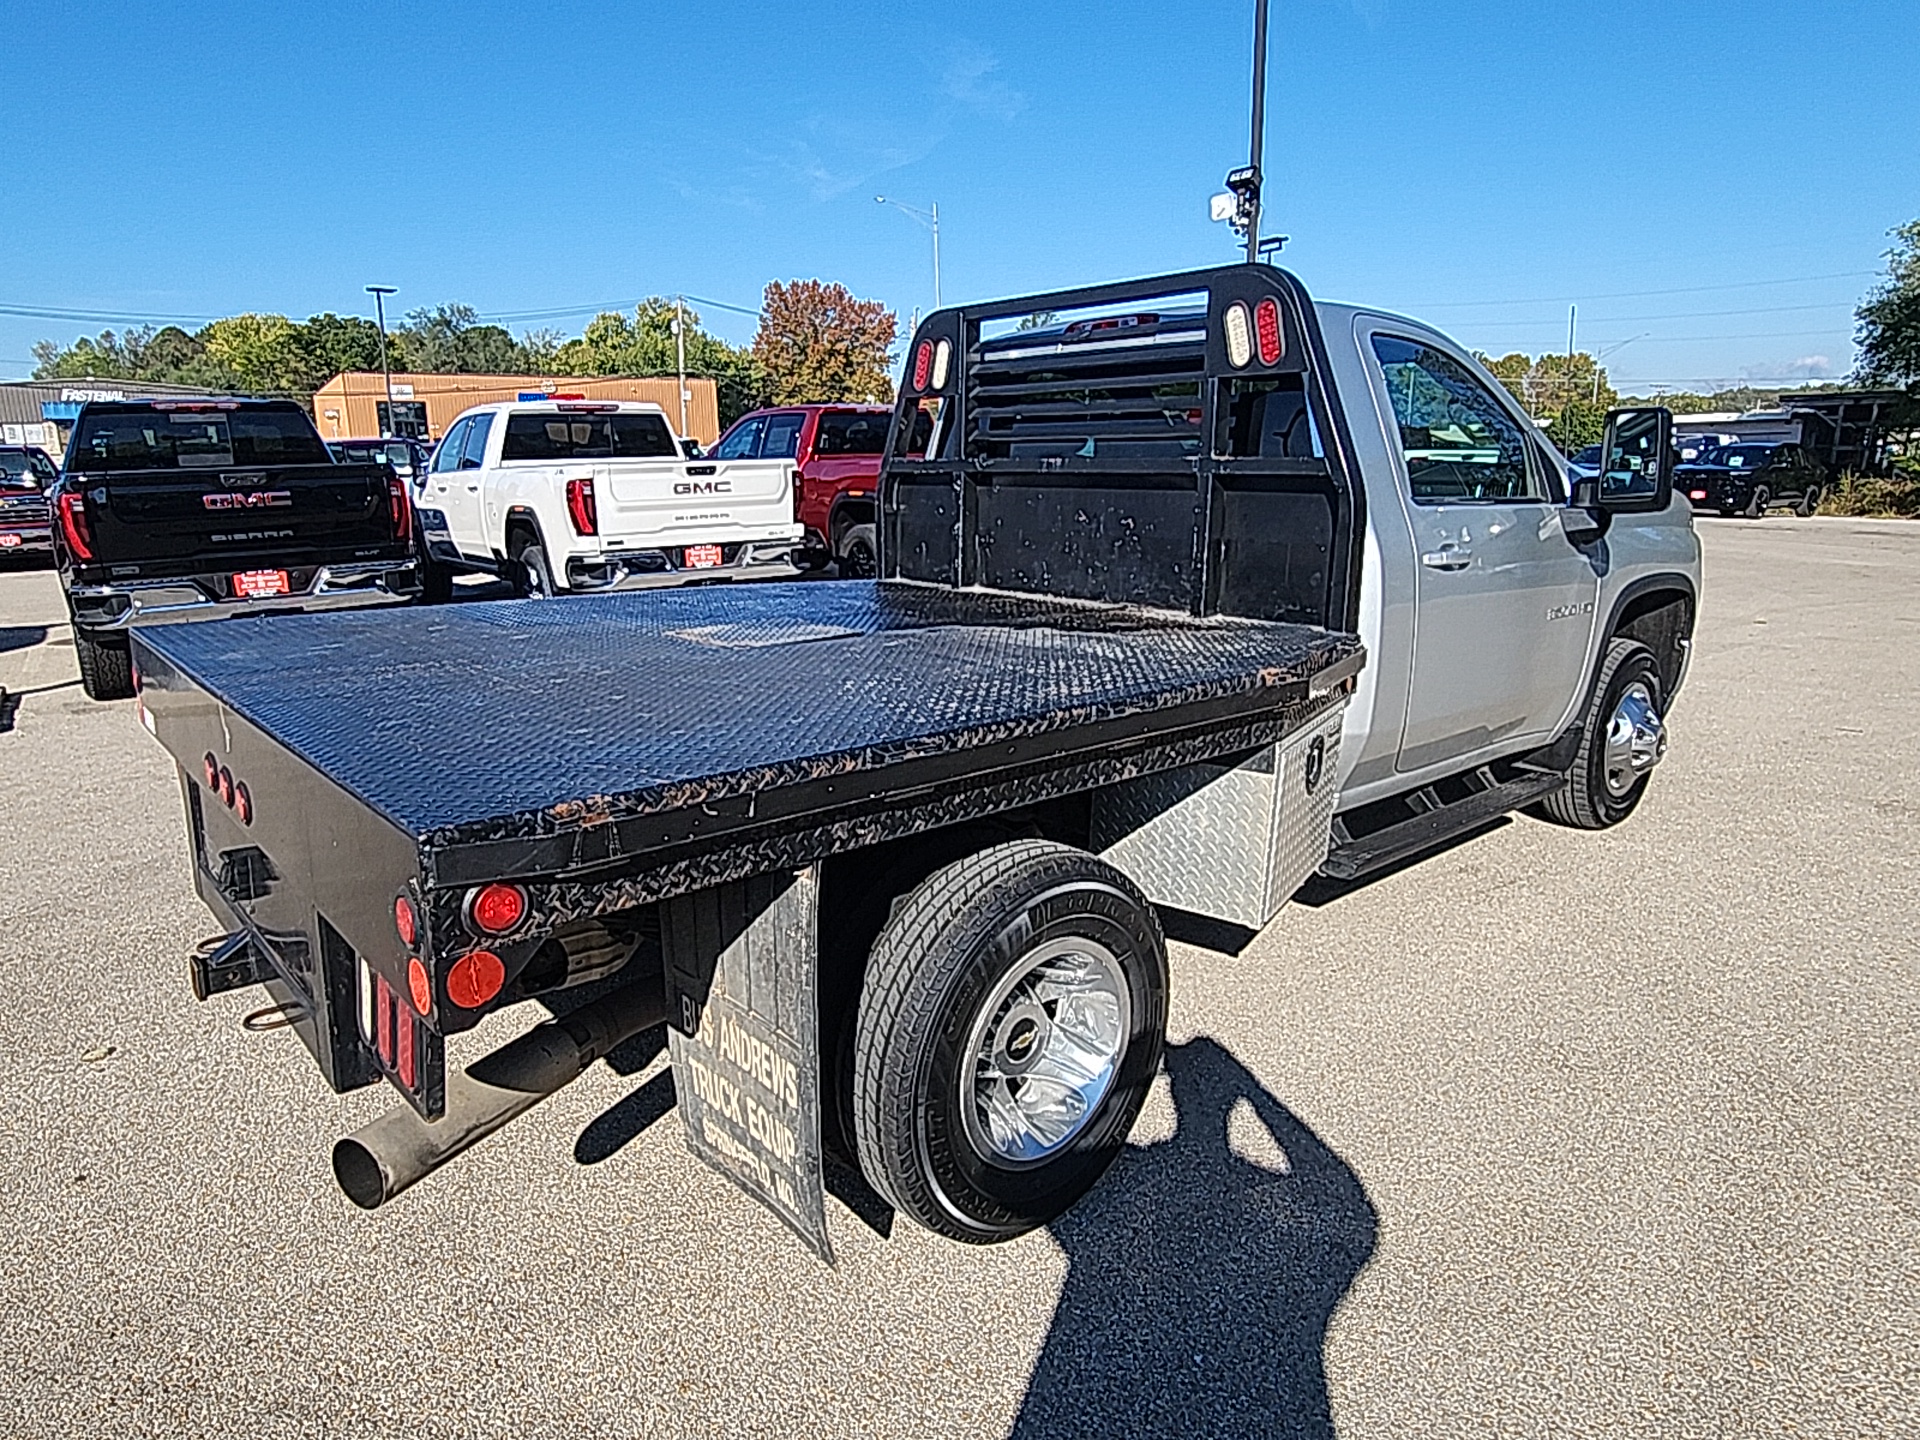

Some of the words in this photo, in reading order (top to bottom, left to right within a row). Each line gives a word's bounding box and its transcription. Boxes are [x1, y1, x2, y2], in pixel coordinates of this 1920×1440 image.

[61, 388, 127, 402] FASTENAL
[673, 481, 732, 495] GMC
[202, 490, 292, 510] GMC
[211, 530, 294, 542] SIERRA
[719, 1015, 798, 1109] ANDREWS
[688, 1055, 746, 1129] TRUCK
